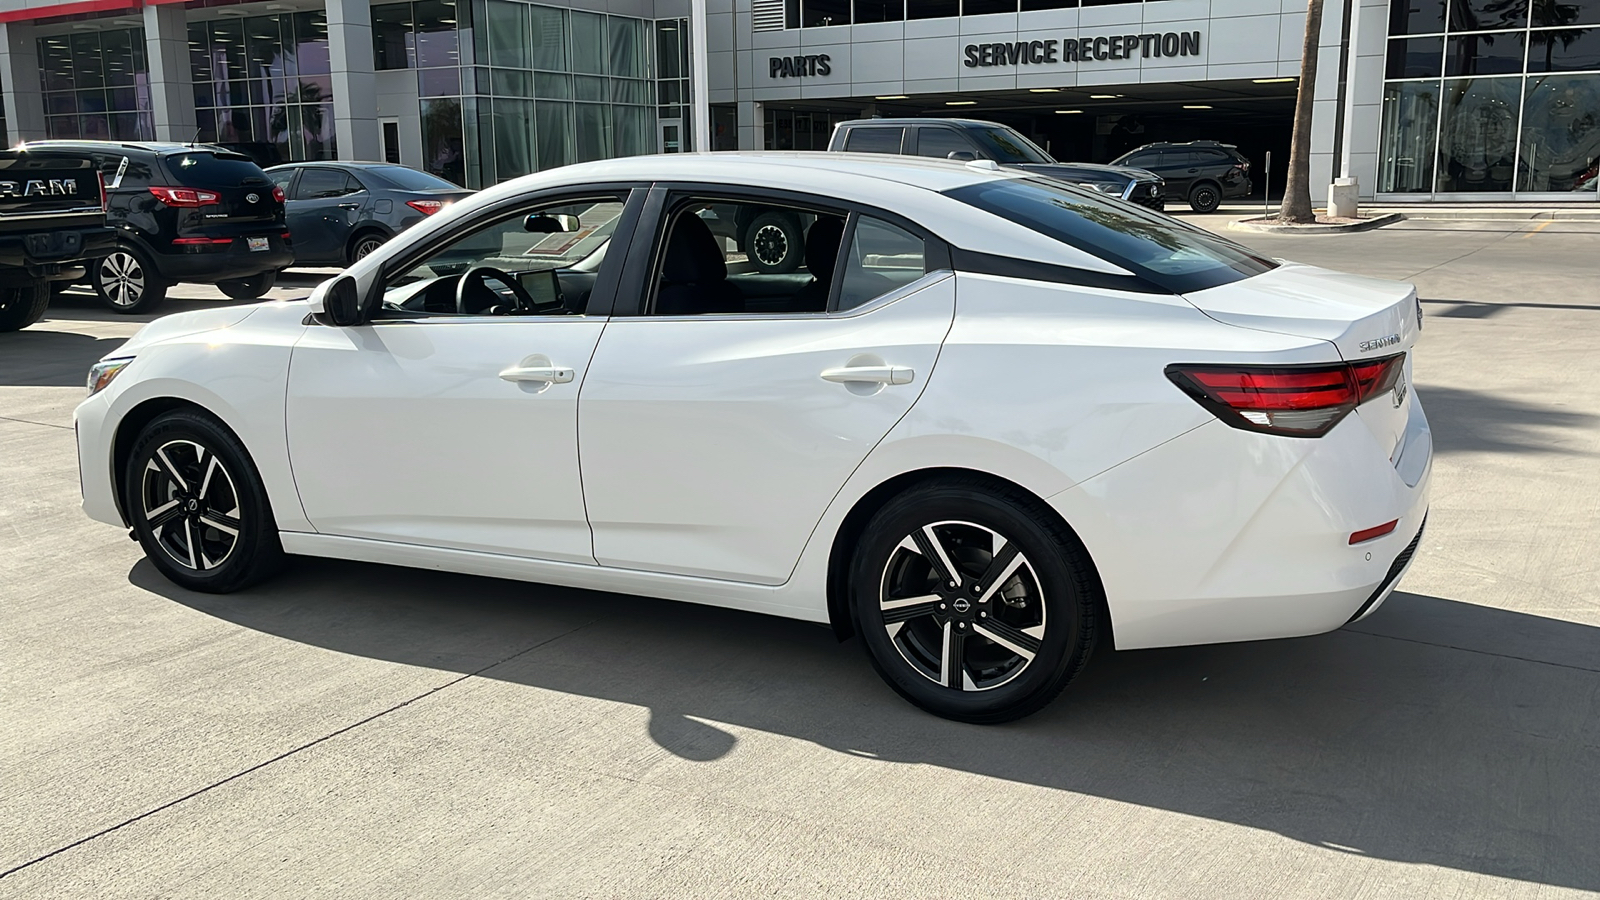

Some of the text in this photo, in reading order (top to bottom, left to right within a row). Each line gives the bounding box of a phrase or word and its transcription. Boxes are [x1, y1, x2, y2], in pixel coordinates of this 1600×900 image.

[964, 31, 1200, 67] SERVICE RECEPTION
[769, 54, 831, 78] PARTS
[0, 178, 77, 198] RAM
